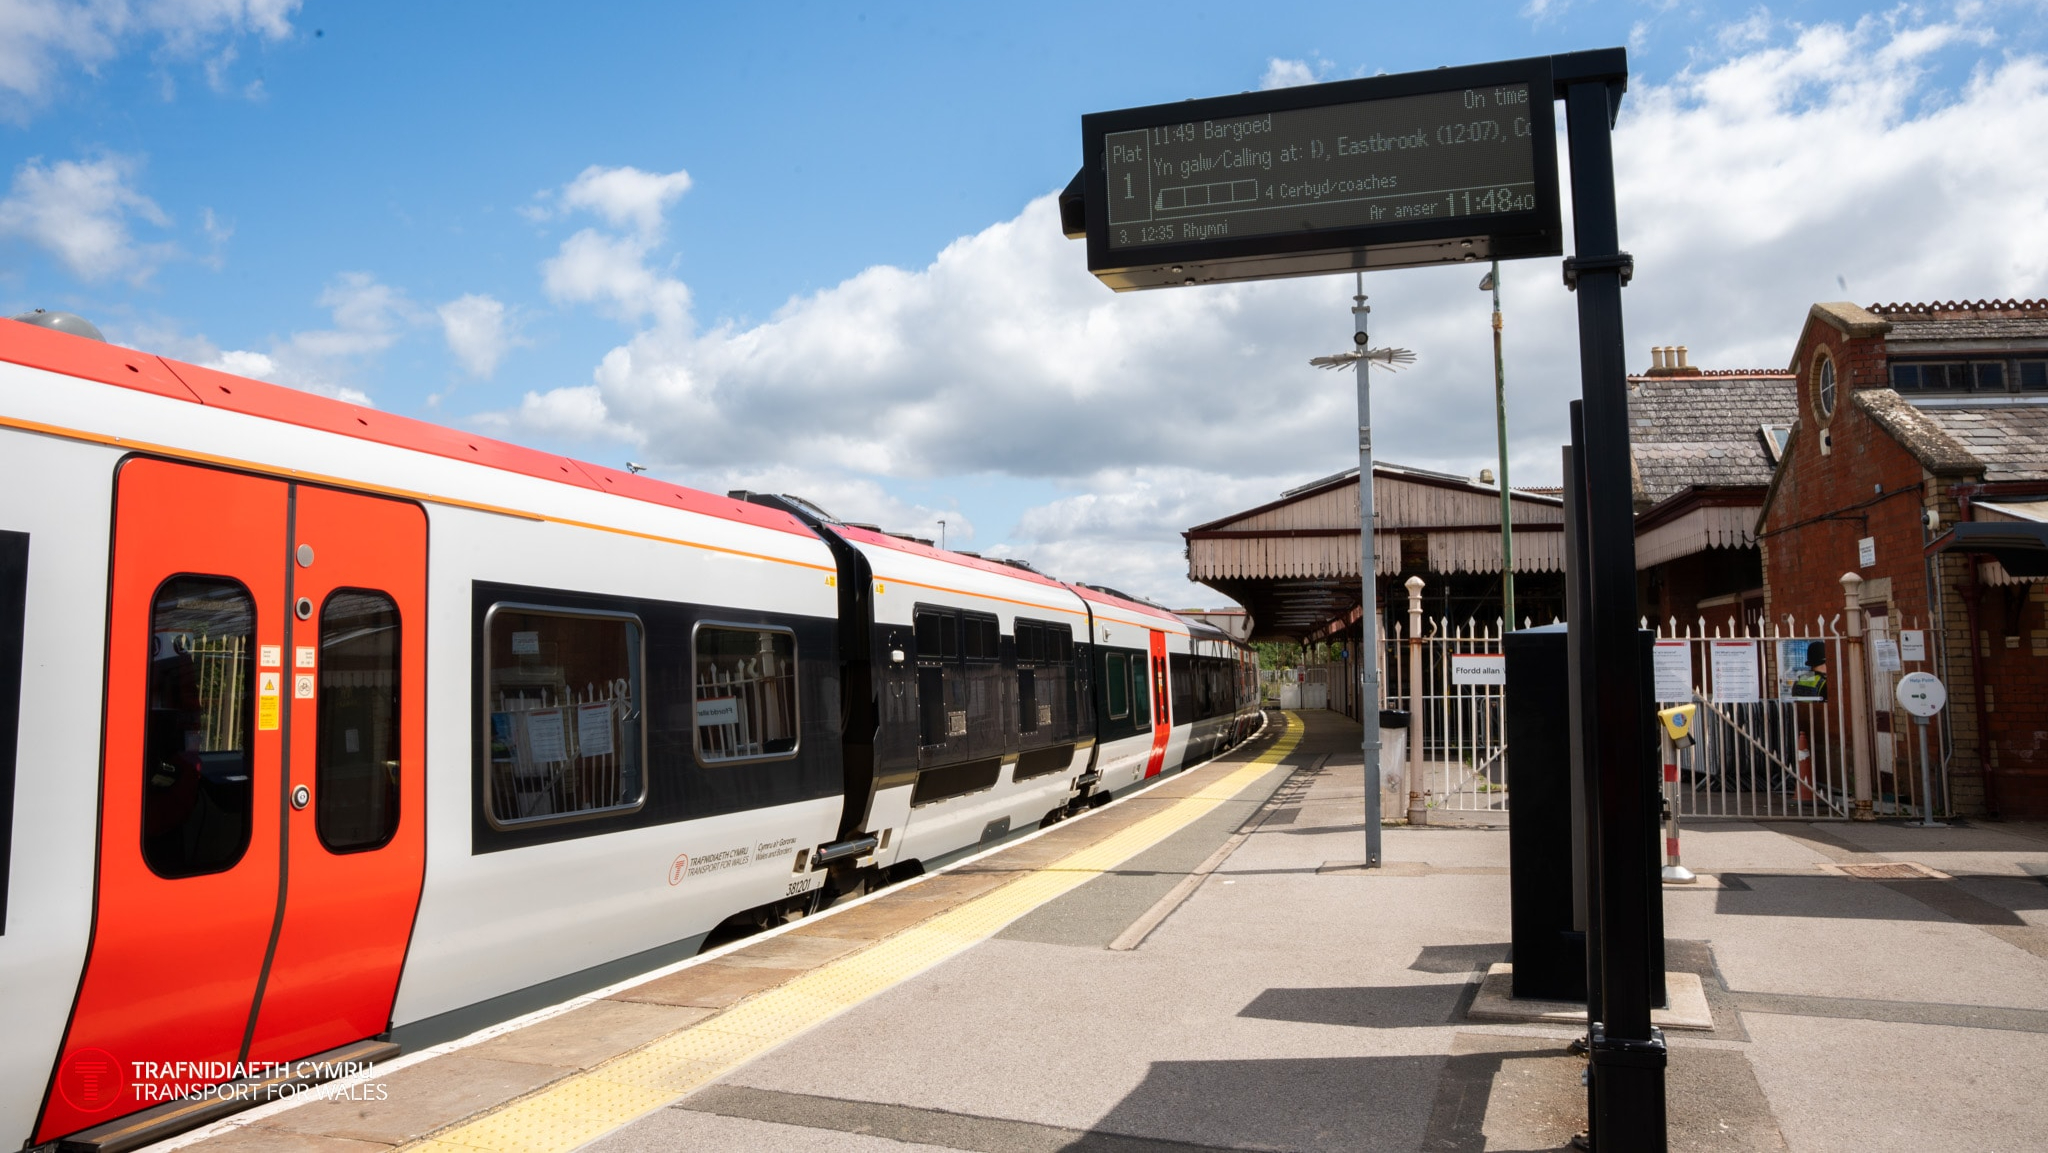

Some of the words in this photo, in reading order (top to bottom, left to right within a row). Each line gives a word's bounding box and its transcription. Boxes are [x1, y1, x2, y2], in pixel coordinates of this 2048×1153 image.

[1464, 89, 1485, 109] On
[1494, 87, 1528, 106] time
[1154, 122, 1195, 146] 11:49
[1204, 113, 1272, 141] Bargoed
[1113, 145, 1143, 163] Plat
[1154, 158, 1173, 176] Yn
[1180, 147, 1272, 178] galw/Calling
[1280, 145, 1303, 162] at:
[1337, 128, 1429, 156] Eastbrook
[1436, 120, 1507, 145] (12:07),
[1123, 173, 1135, 199] 1
[1265, 184, 1274, 199] 4
[1280, 174, 1397, 199] Cerbyd/coaches
[1370, 204, 1387, 220] Ar
[1395, 202, 1438, 218] amser
[1119, 229, 1131, 244] 3.
[1141, 225, 1174, 242] 12:35
[1183, 219, 1228, 240] Rhymni
[1456, 667, 1481, 675] Ffordd
[1483, 667, 1500, 675] allan
[690, 851, 729, 866] TRAFNIDIAETH
[729, 847, 749, 859] CYMRU
[755, 851, 767, 860] Wales
[767, 850, 777, 859] and
[688, 863, 720, 876] TRANSPORT
[720, 859, 732, 869] FOR
[732, 856, 749, 867] WALES
[786, 878, 811, 896] 381201
